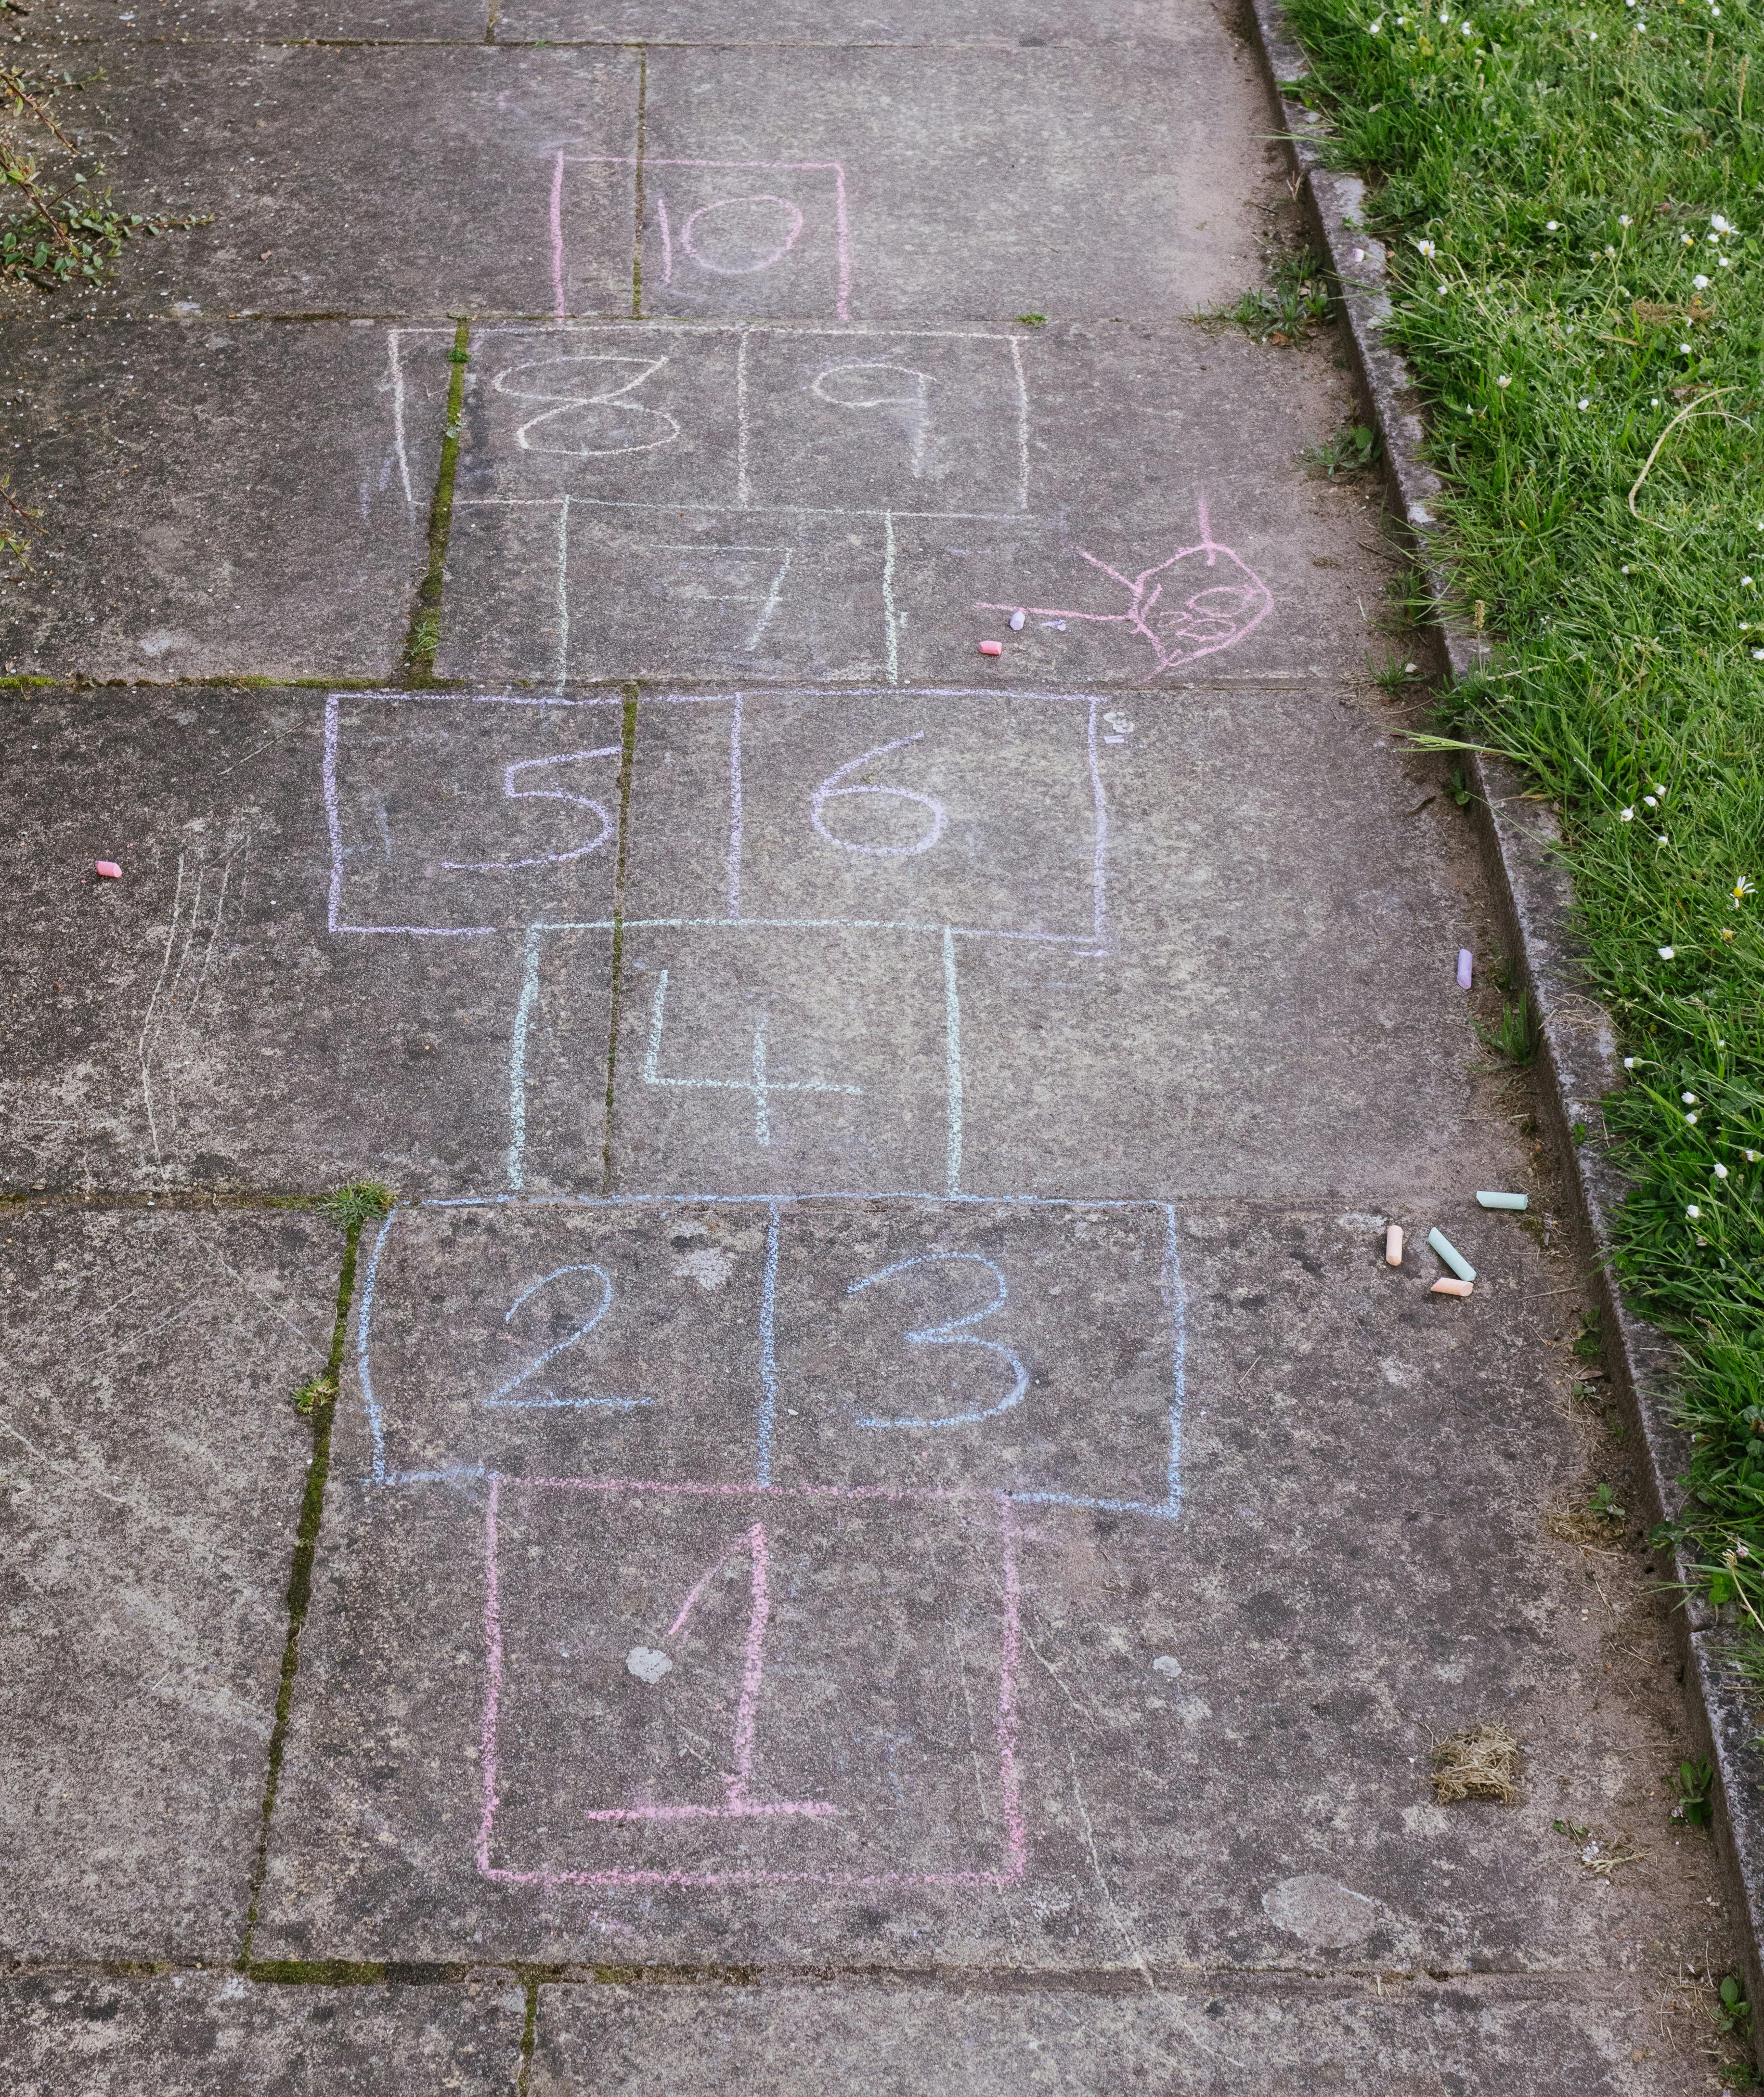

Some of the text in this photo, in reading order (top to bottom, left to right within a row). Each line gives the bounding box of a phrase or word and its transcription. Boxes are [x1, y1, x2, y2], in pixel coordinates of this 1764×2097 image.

[657, 193, 804, 286] 10
[491, 354, 682, 456] 8
[810, 362, 938, 478] 9
[649, 543, 794, 652] 7
[442, 745, 622, 871] 5
[810, 730, 948, 858] 6
[643, 968, 864, 1145] 4
[481, 1262, 655, 1409] 2
[845, 1251, 1029, 1429] 3
[587, 1521, 835, 1822] 1
